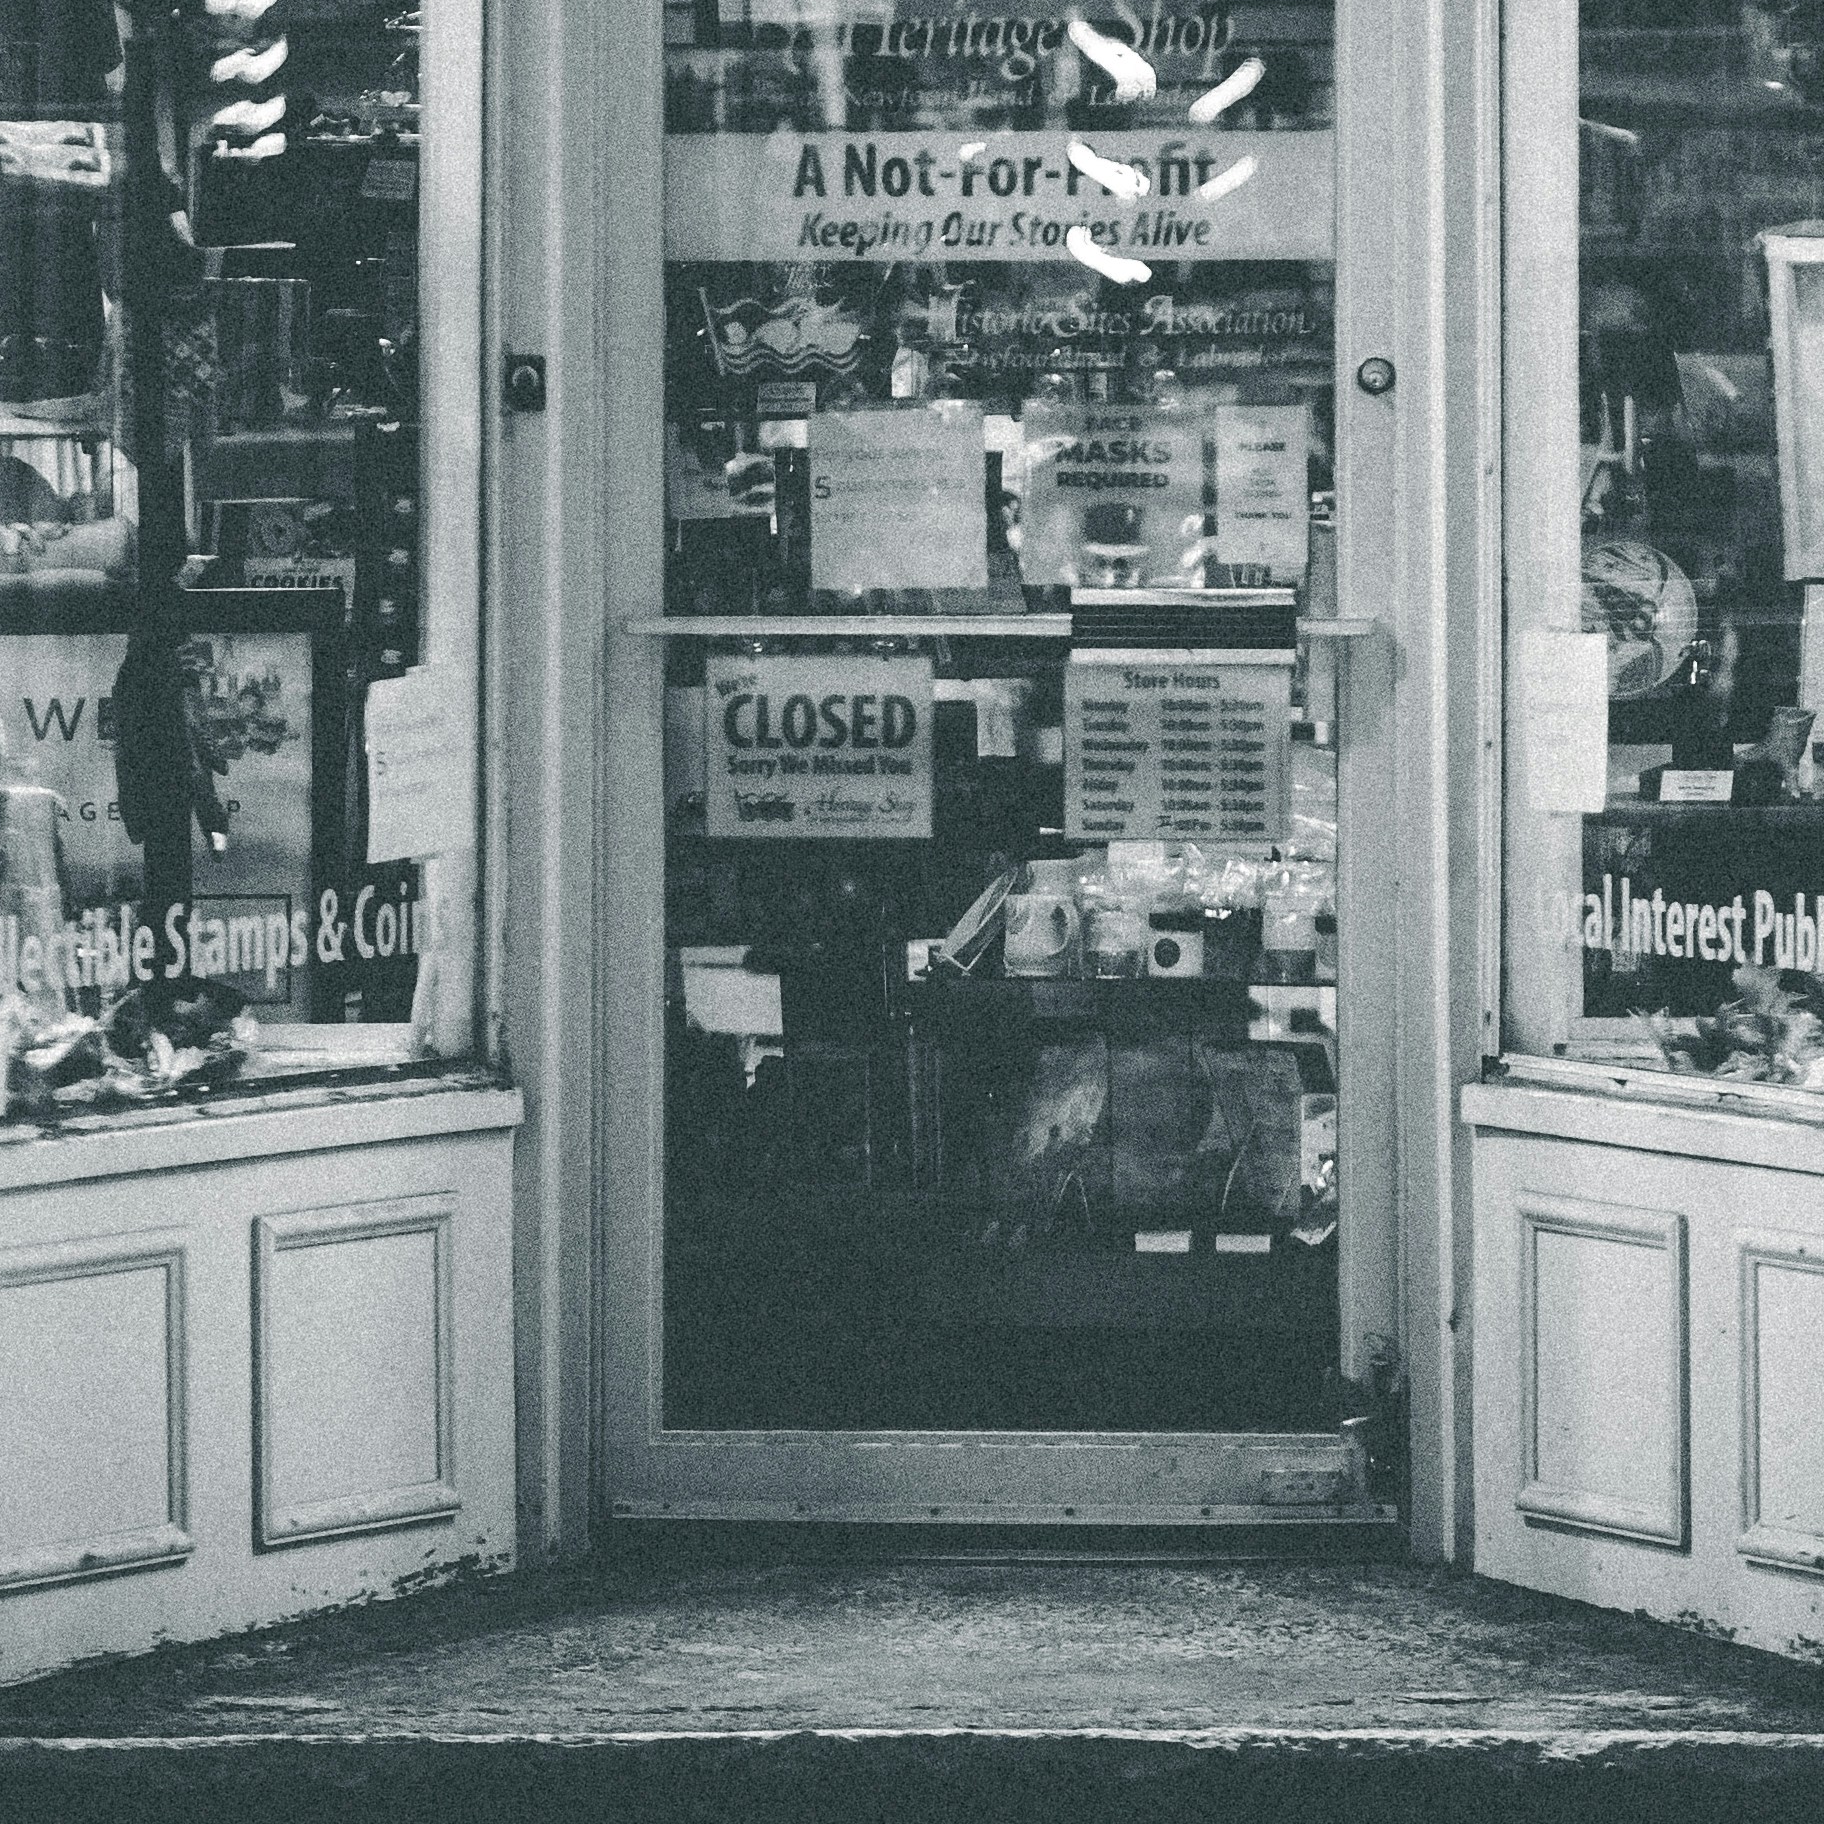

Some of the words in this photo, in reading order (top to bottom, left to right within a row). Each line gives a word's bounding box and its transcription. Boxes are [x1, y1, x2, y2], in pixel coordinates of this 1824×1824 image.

[792, 143, 827, 197] A
[797, 213, 933, 257] Keeping
[941, 213, 1002, 248] Our
[1129, 213, 1212, 248] Alive
[1139, 294, 1316, 337] Association
[1055, 440, 1172, 465] MASKS
[1055, 470, 1169, 490] REQUIRED
[1122, 671, 1169, 689] Store
[1173, 671, 1221, 689] Hours
[723, 693, 917, 749] CLOSED
[727, 754, 777, 780] Sorry
[778, 754, 809, 775] We
[811, 754, 876, 776] Missed
[877, 754, 913, 776] You
[164, 901, 309, 991] Stamps
[316, 887, 347, 964] &
[1619, 876, 1748, 963] Interest
